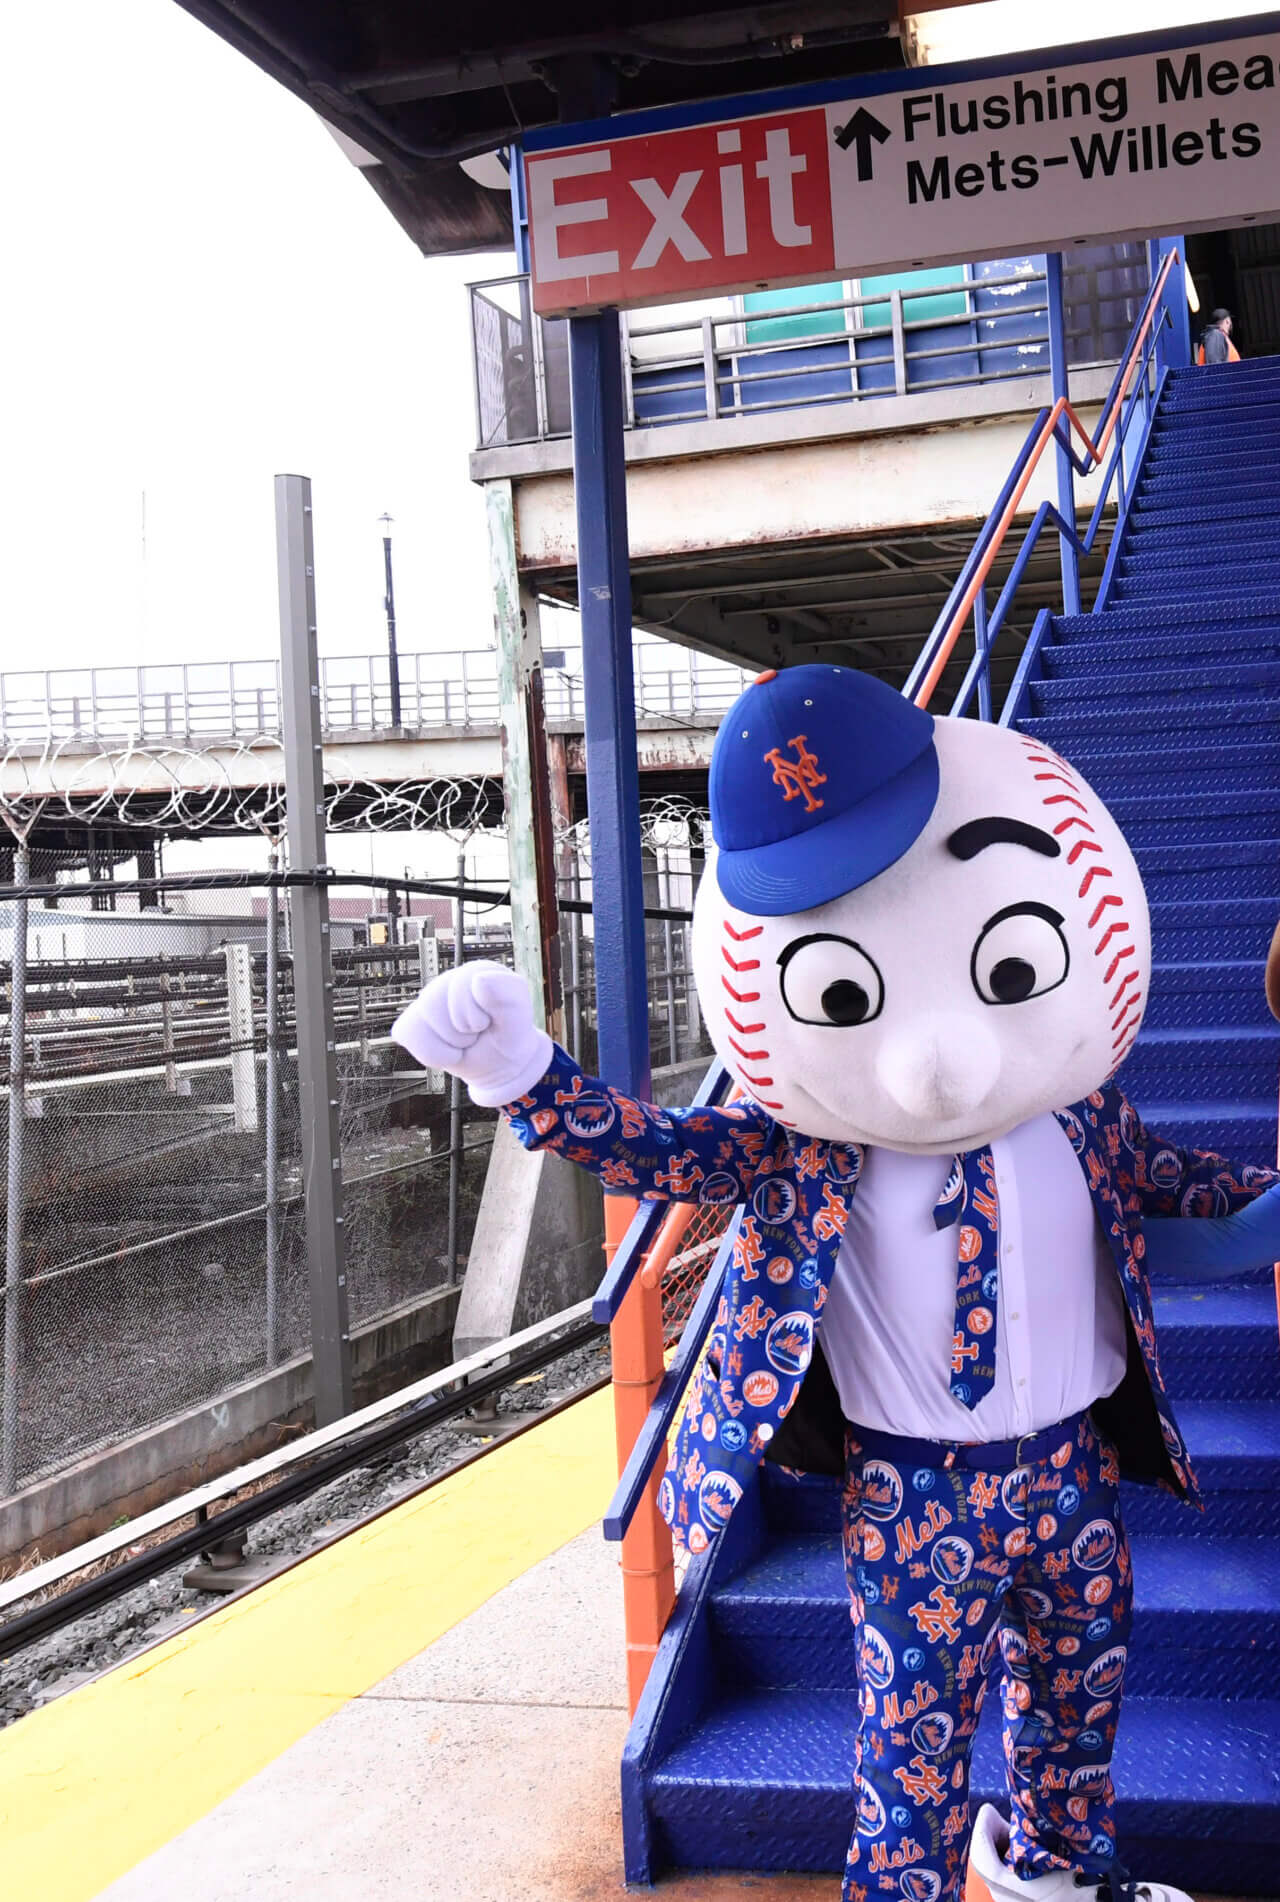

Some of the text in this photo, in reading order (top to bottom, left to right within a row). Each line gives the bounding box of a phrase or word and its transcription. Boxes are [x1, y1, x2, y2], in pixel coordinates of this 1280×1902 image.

[902, 72, 1129, 143] Flushing
[907, 115, 1262, 205] Mets-Willets
[531, 127, 814, 284] Exit
[895, 1500, 953, 1564] Mets
[880, 1680, 939, 1730] Mets
[868, 1836, 925, 1873] Mets
